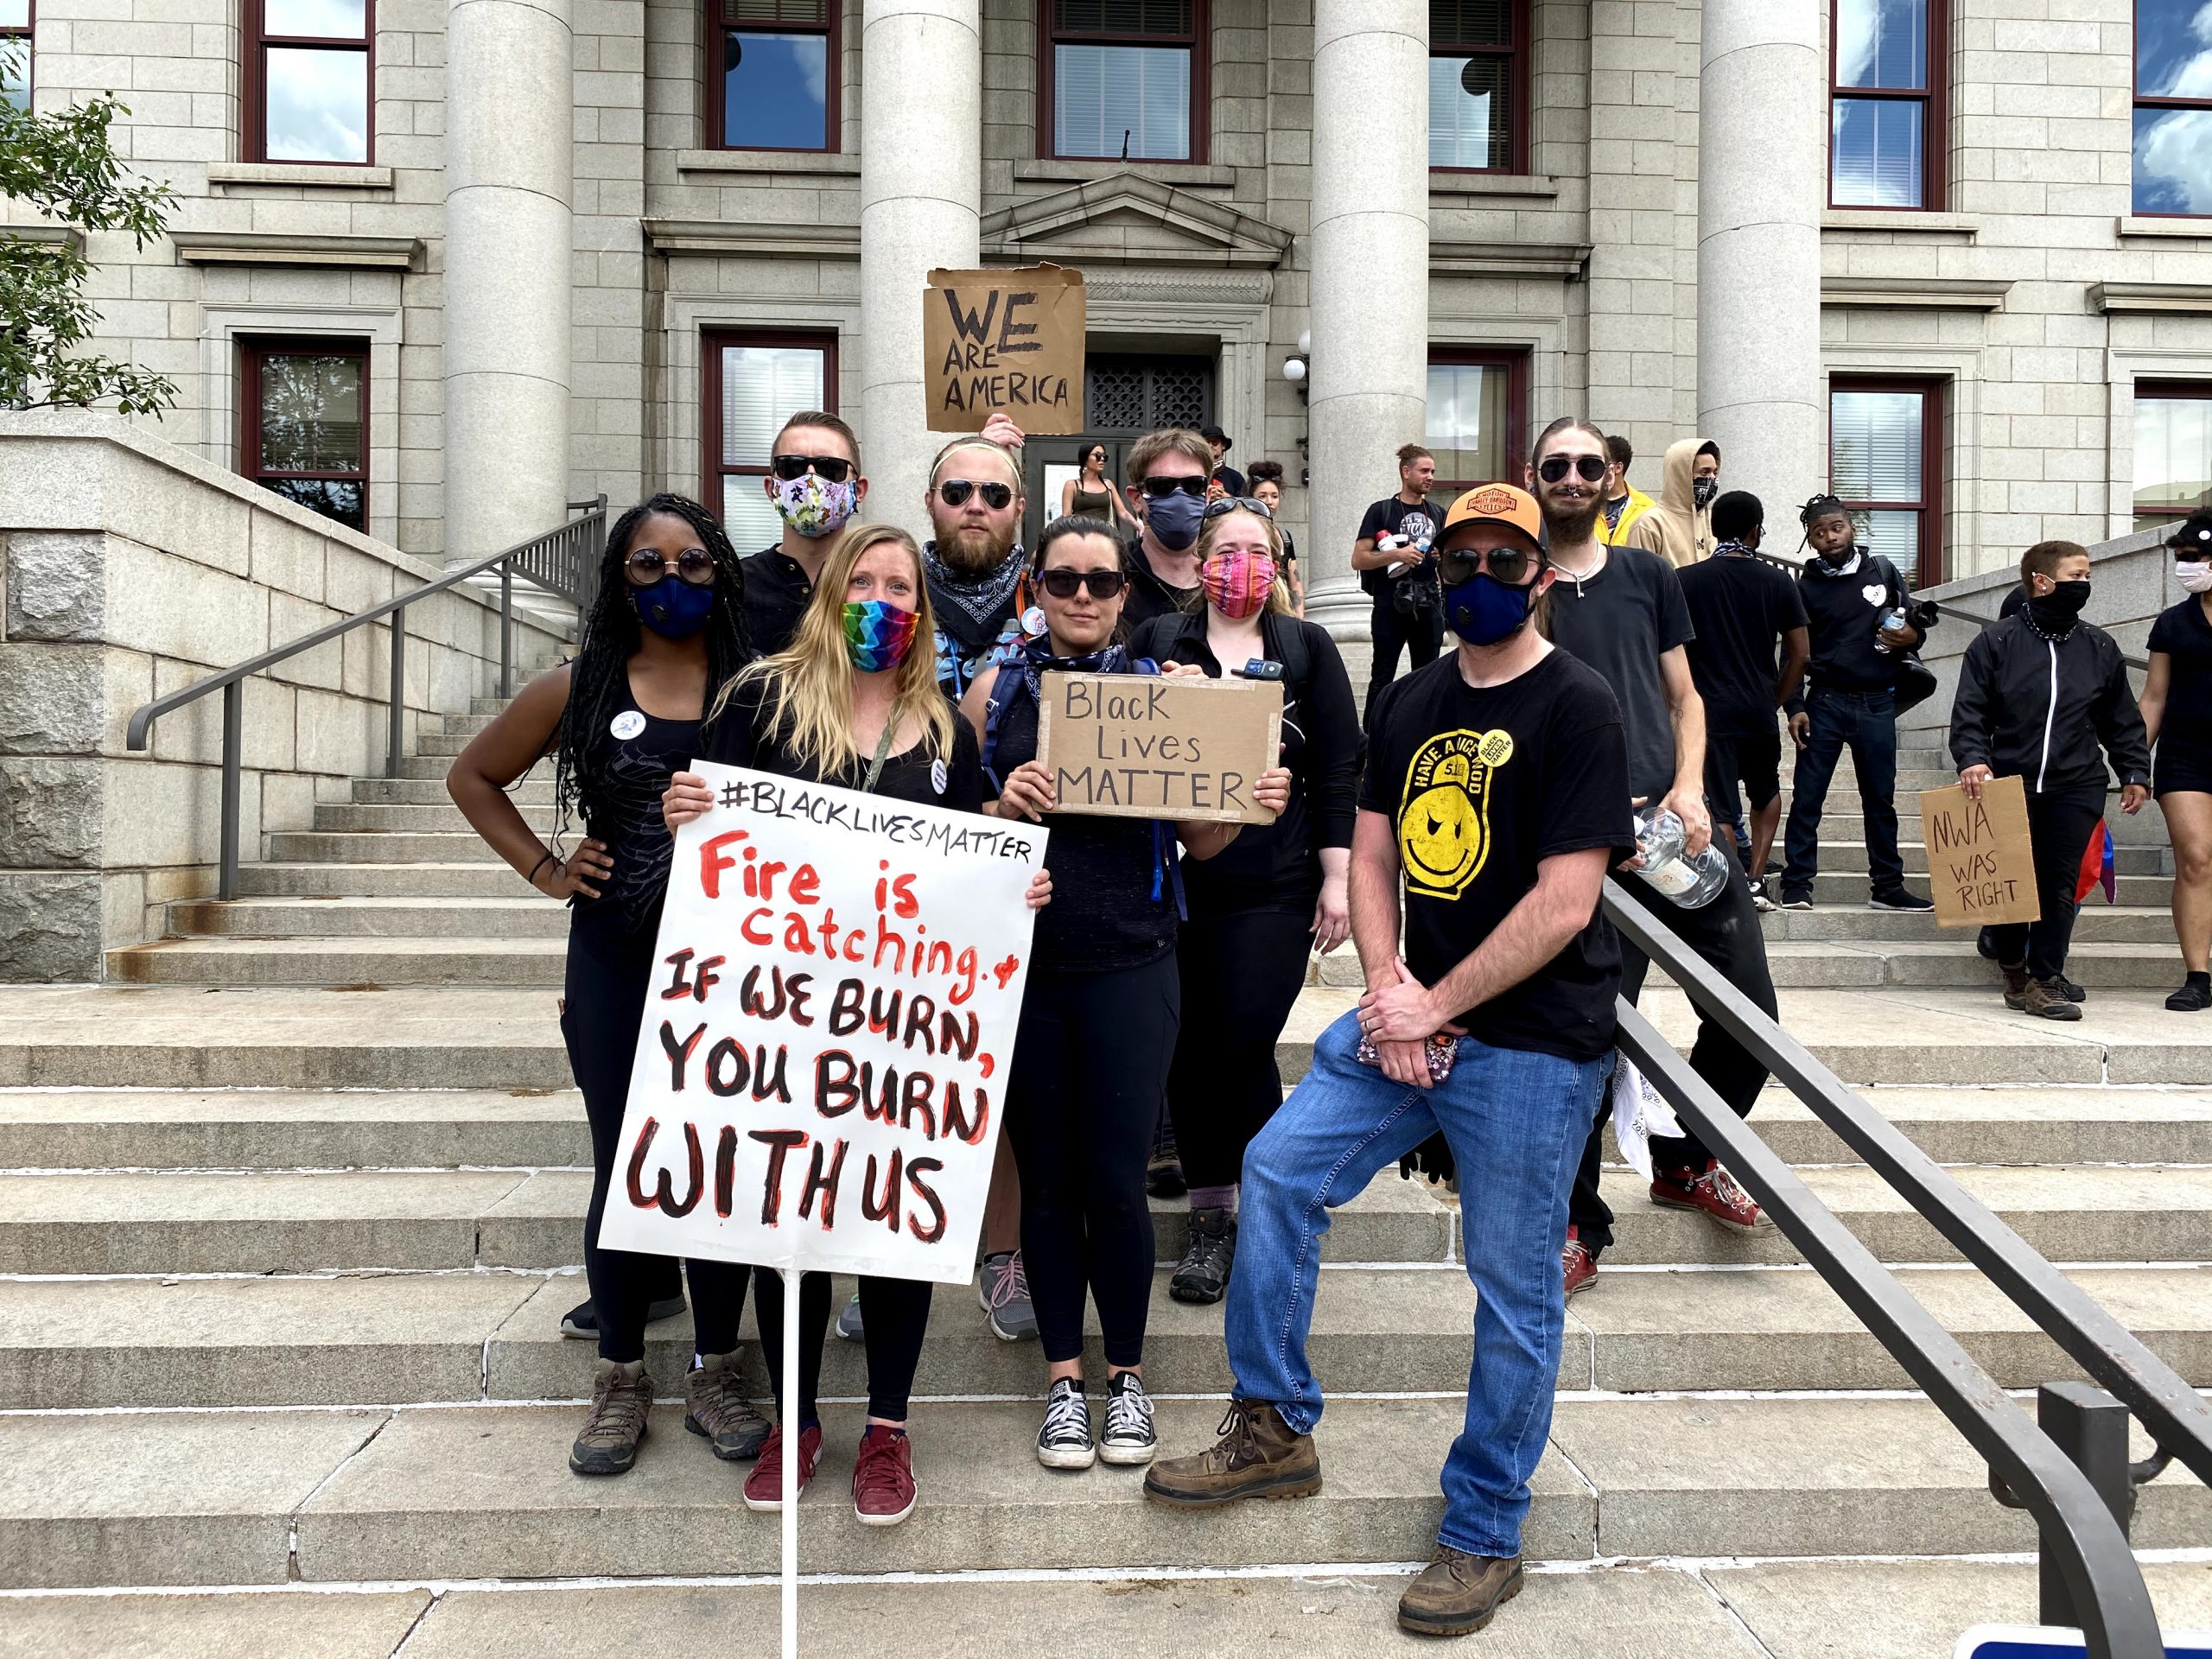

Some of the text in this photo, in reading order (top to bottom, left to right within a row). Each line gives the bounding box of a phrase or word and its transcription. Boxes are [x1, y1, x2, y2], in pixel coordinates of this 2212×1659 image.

[943, 289, 1044, 354] WE
[943, 338, 1000, 376] ARE
[944, 372, 1069, 414] AMERICA
[1065, 681, 1171, 721] Black
[1097, 725, 1201, 763] Lives
[1414, 747, 1442, 787] HAVE
[1445, 740, 1455, 754] A
[1480, 735, 1498, 756] BLACK
[1485, 740, 1503, 760] LIVES
[1491, 741, 1511, 765] MATTER
[1057, 766, 1248, 810] MATTER
[1933, 802, 1994, 854] NWA
[699, 830, 919, 918] Fire is
[1950, 850, 1998, 884] WAS
[1956, 880, 2018, 912] RIGHT
[660, 947, 995, 1079] IF WE BURN,
[659, 1020, 989, 1146] YOU BURN
[626, 1116, 947, 1244] WITH US
